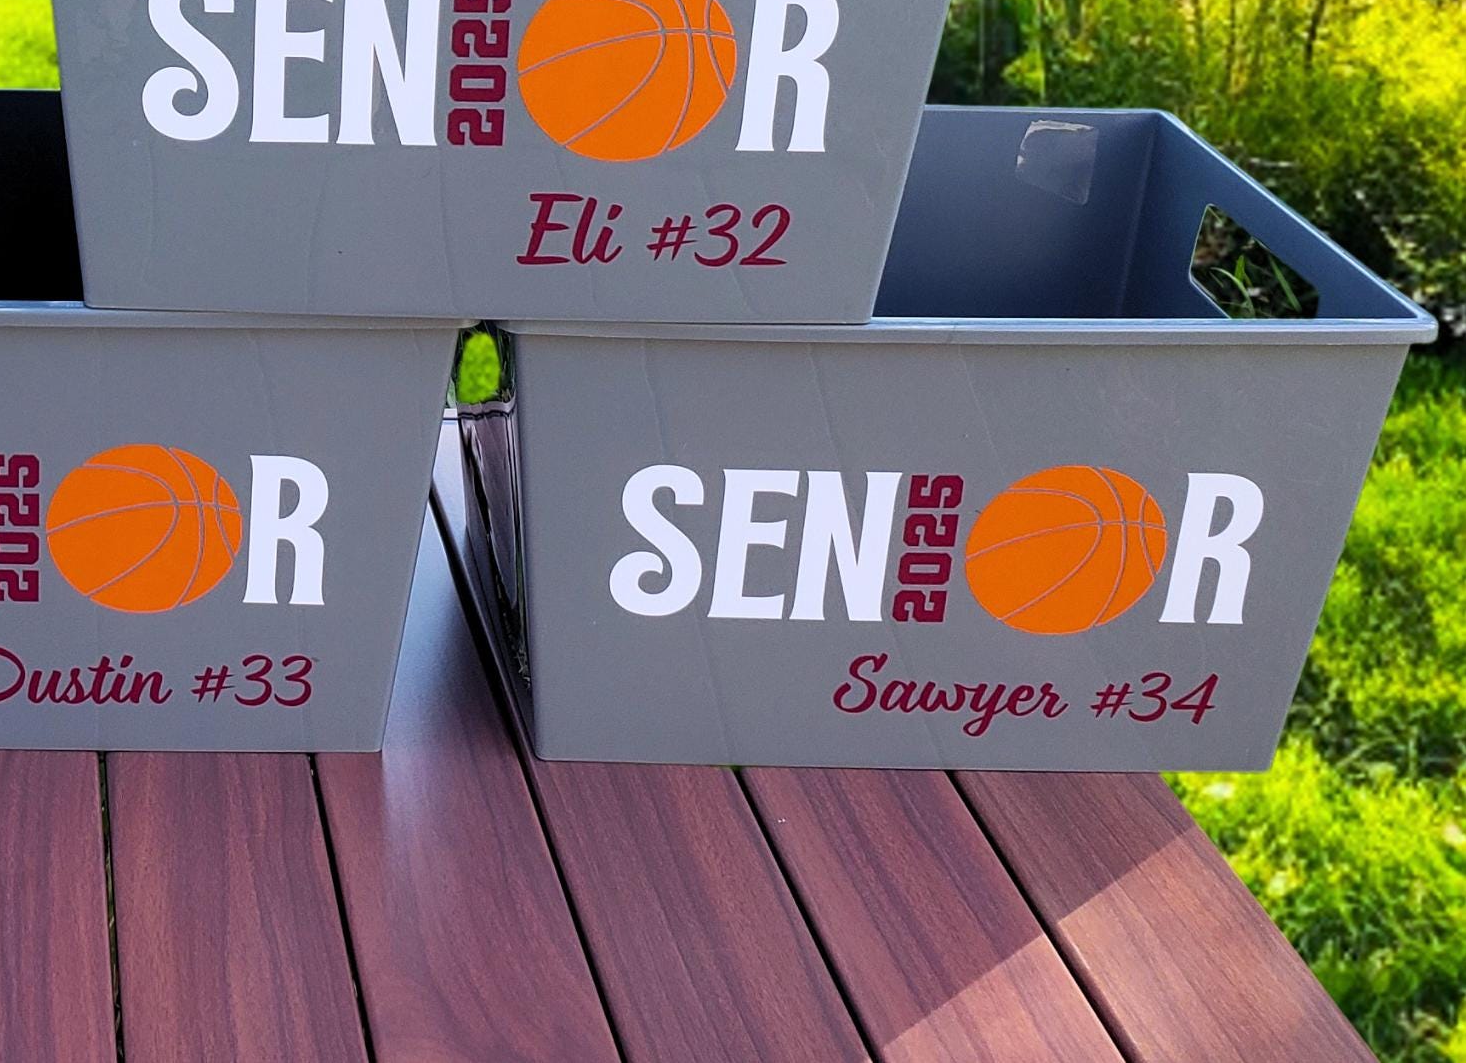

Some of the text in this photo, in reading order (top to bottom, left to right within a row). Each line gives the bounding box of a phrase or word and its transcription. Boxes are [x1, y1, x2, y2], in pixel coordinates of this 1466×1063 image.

[516, 192, 791, 268] Eli #32
[891, 474, 964, 623] 2025
[191, 654, 313, 707] #33
[832, 653, 1219, 737] Sawyer #34
